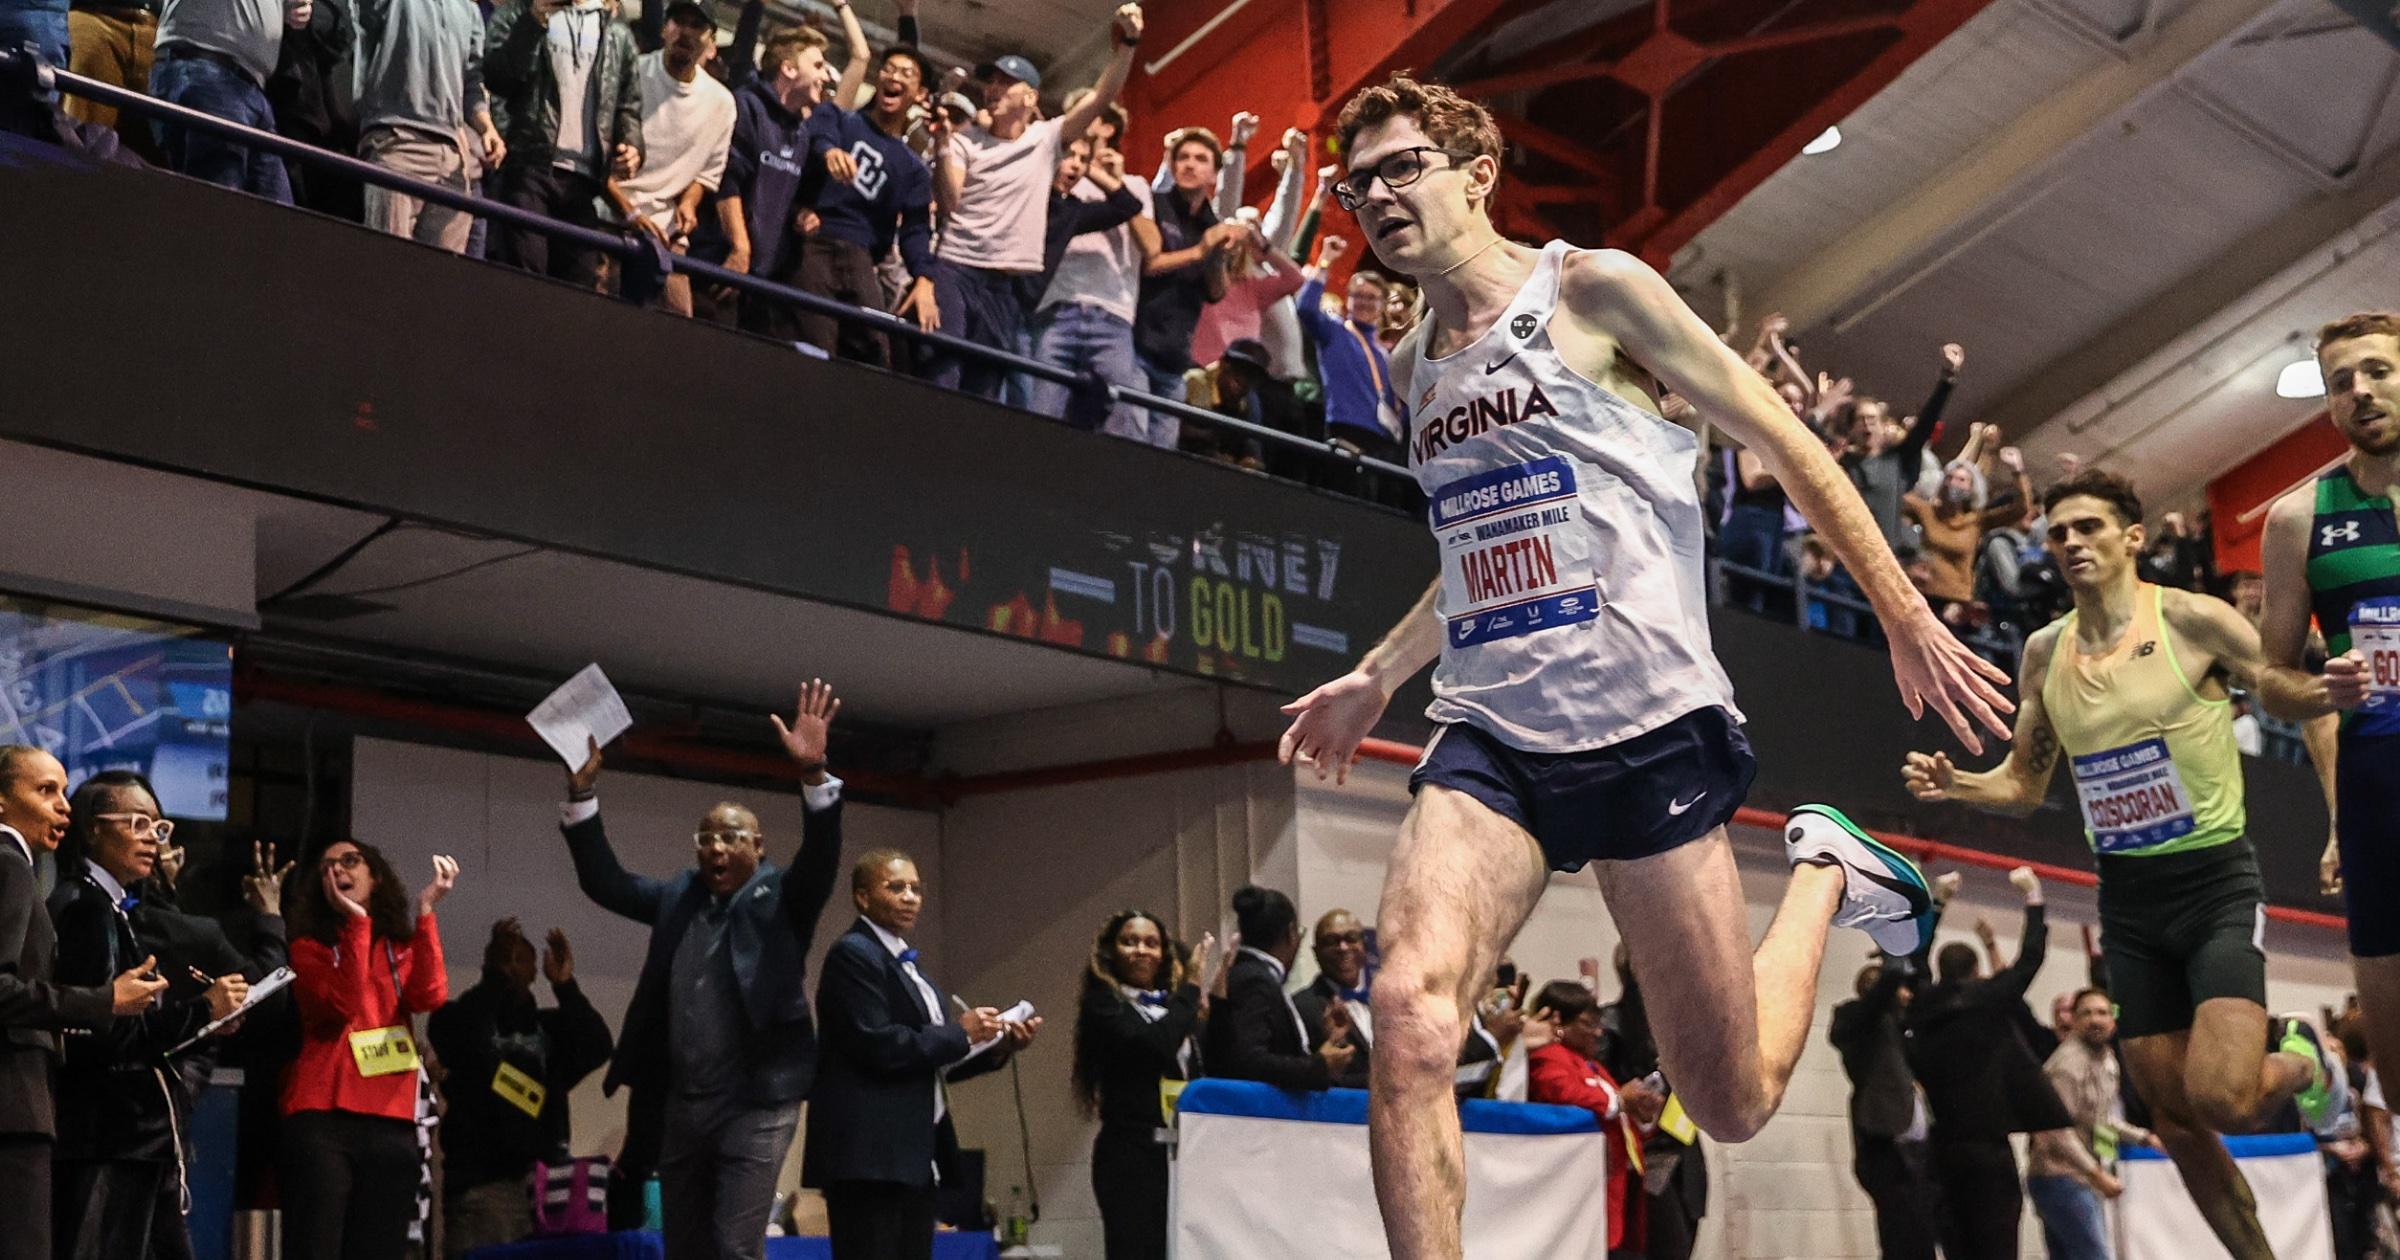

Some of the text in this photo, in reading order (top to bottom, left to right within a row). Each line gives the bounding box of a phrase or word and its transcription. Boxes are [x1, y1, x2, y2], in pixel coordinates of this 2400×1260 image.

[1412, 383, 1559, 465] VIRGINIA
[1439, 471, 1561, 519] MILLROSE GAMES
[1475, 513, 1539, 541] WANAMAKER
[1541, 506, 1570, 527] MILE
[1460, 534, 1557, 604] MARTIN
[1129, 561, 1284, 662] TO GOLD
[2088, 782, 2179, 827] COSCORAN
